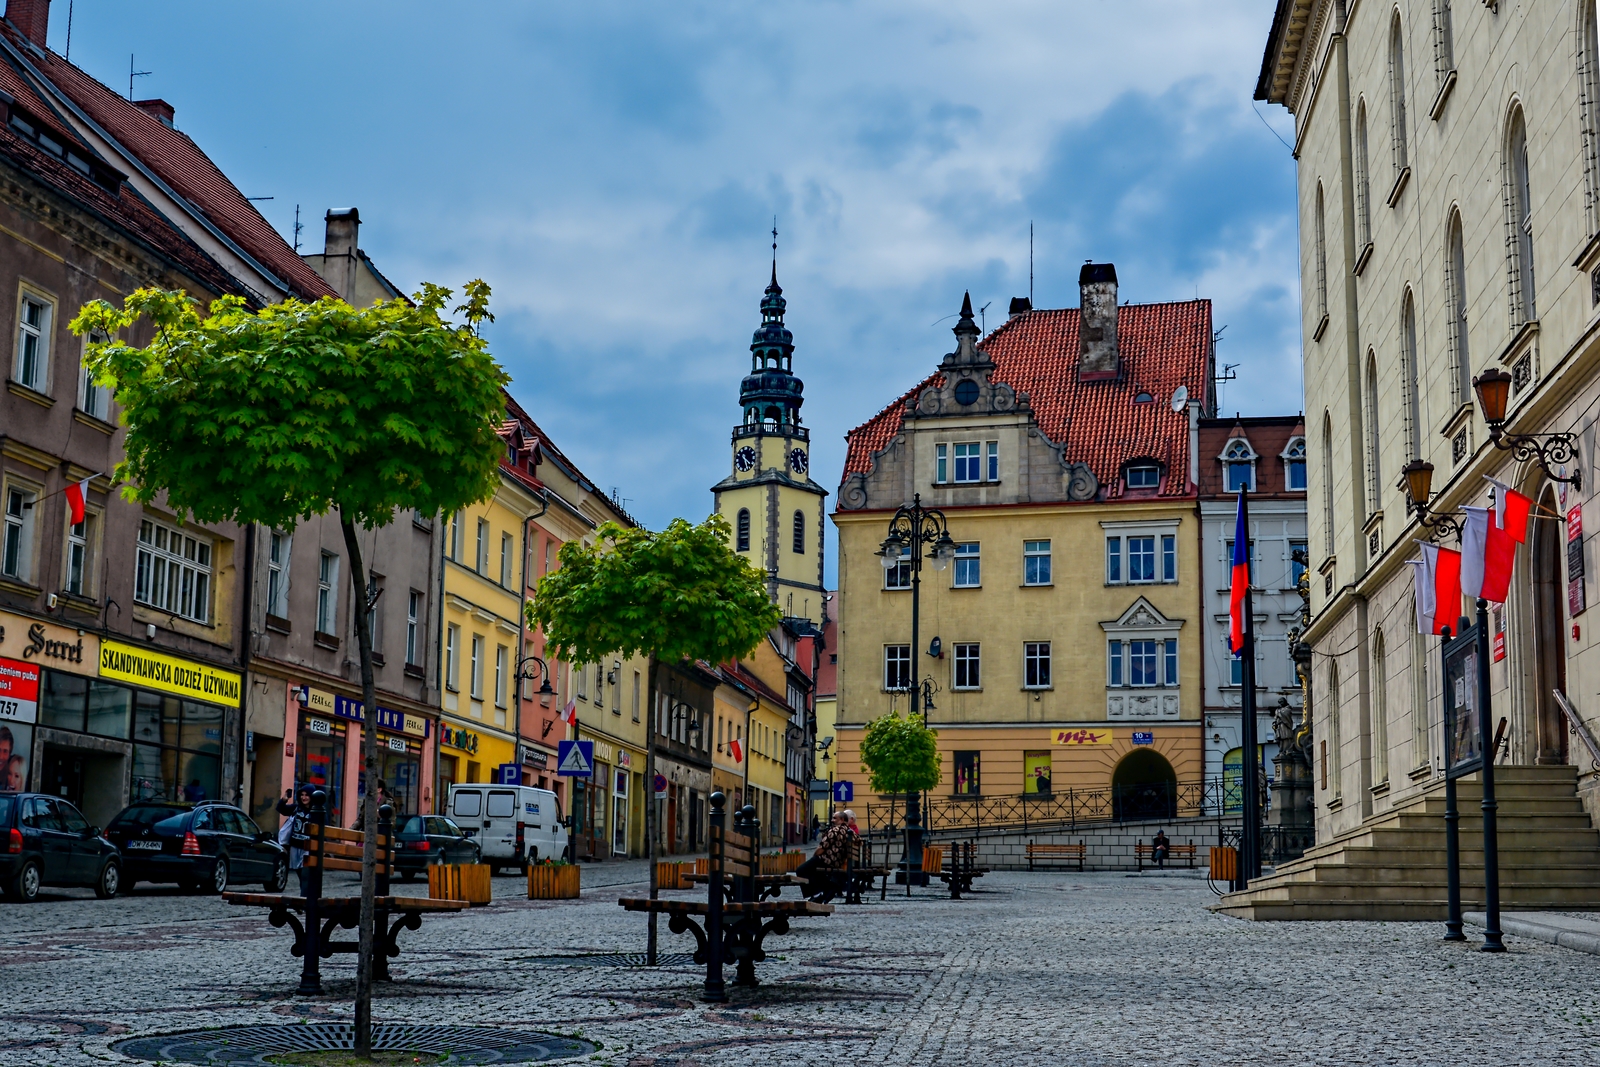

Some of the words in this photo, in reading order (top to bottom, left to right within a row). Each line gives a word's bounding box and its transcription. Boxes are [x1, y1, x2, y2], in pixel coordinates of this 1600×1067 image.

[102, 648, 172, 684] SKANDYNAWSKA
[174, 667, 202, 691] ODZIEŻ
[203, 671, 239, 700] UŻYWANA
[311, 694, 324, 705] FEAX
[342, 700, 398, 727] TKAINY
[406, 719, 417, 729] FEAX
[595, 741, 612, 761] MODY
[504, 766, 517, 784] P
